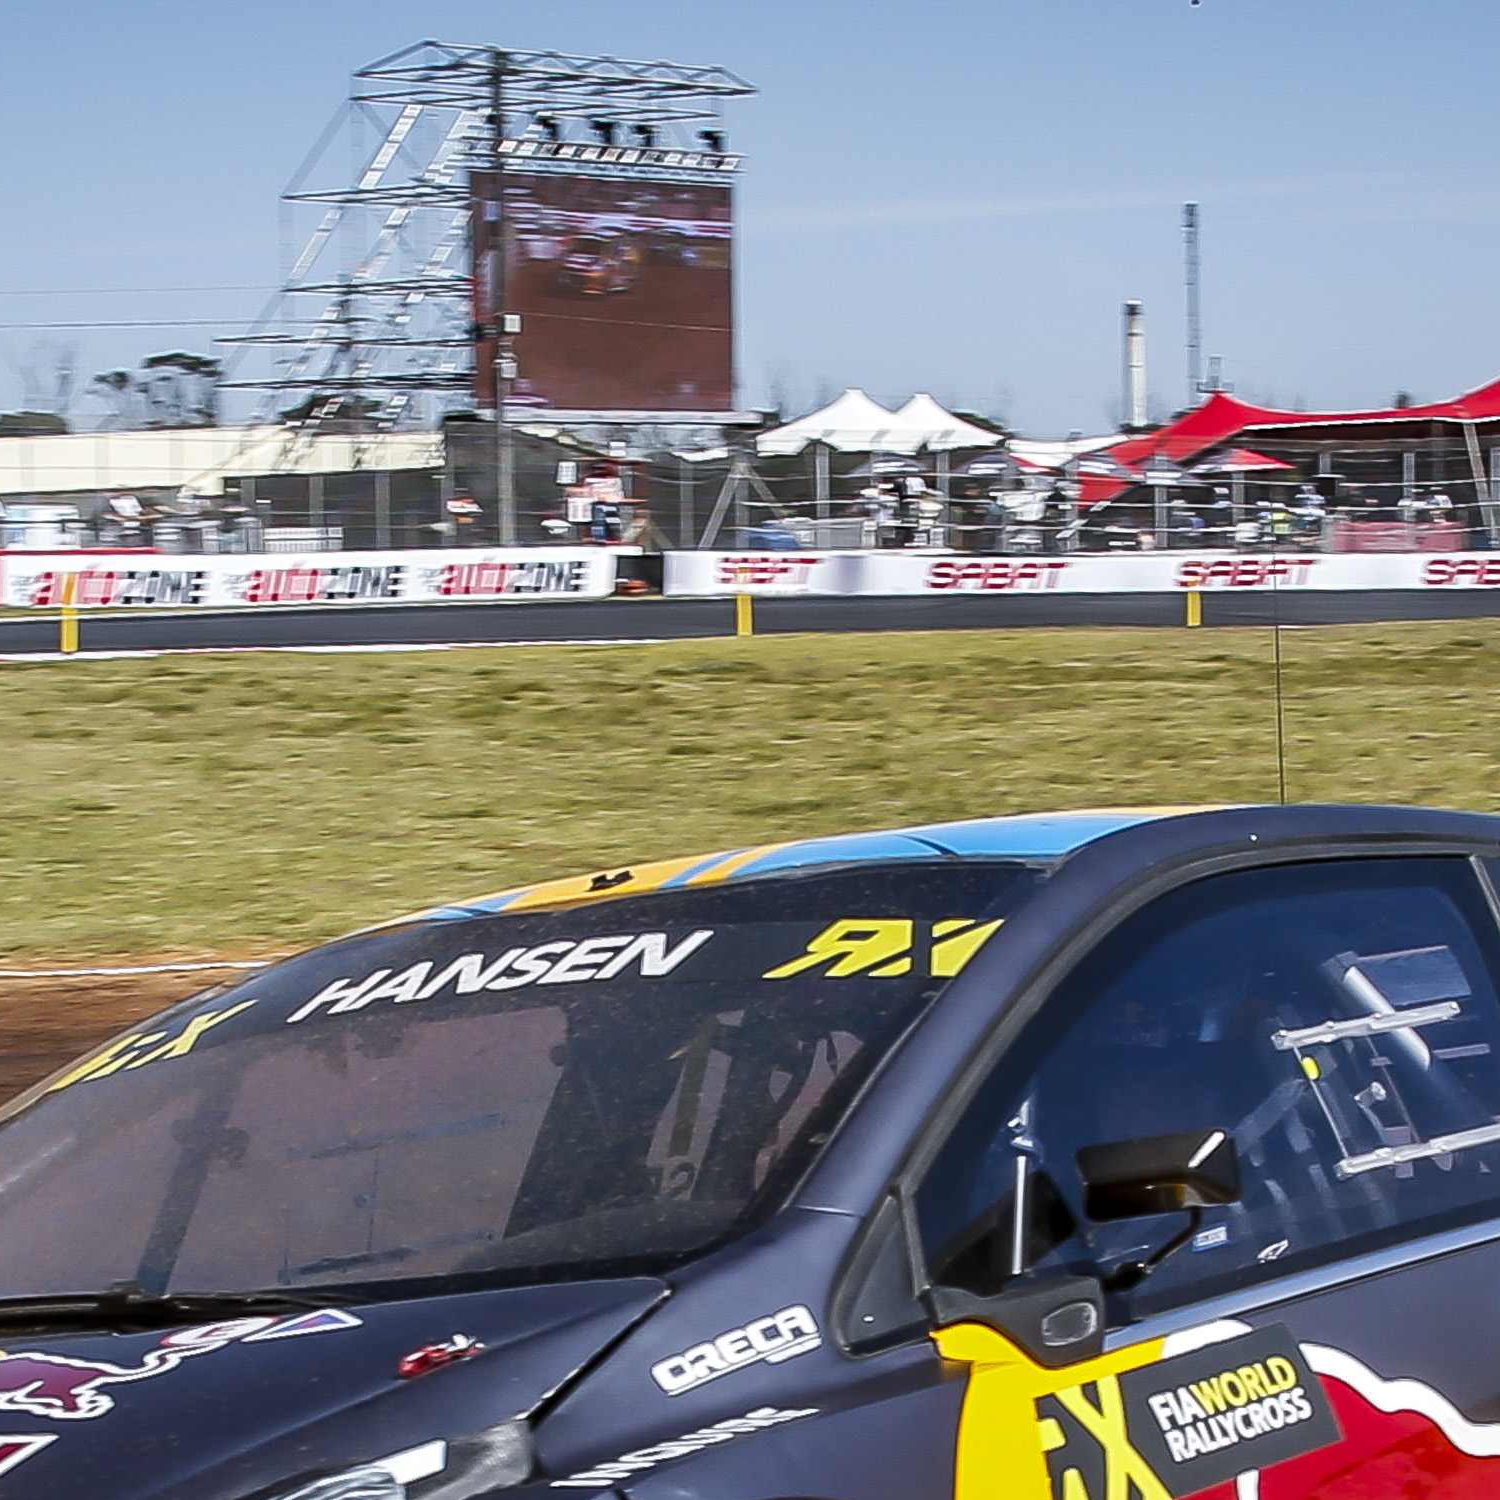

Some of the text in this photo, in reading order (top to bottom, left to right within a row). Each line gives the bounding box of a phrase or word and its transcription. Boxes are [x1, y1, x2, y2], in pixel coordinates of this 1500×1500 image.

[287, 929, 714, 1023] HANSEN
[652, 1303, 818, 1391] ORECA
[1164, 1387, 1313, 1462] RALLYCROSS
